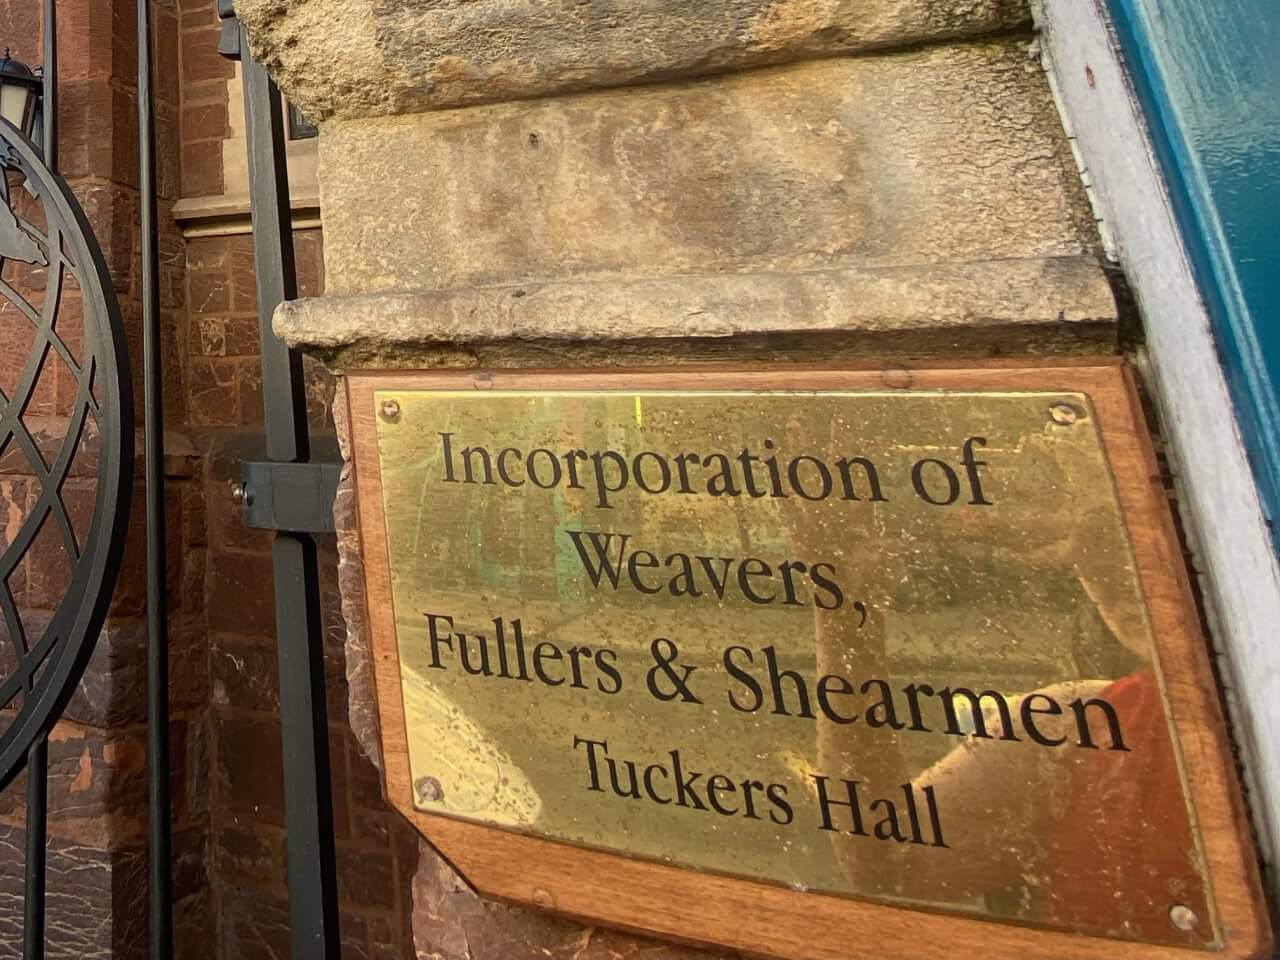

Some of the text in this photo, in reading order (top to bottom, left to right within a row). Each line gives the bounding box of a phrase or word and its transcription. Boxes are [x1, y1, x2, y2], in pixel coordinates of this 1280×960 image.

[440, 431, 994, 509] Incorporation of
[566, 529, 868, 627] Weavers,
[423, 612, 1133, 753] Fullers & Shearmen
[573, 735, 949, 849] Tuckers Hall
